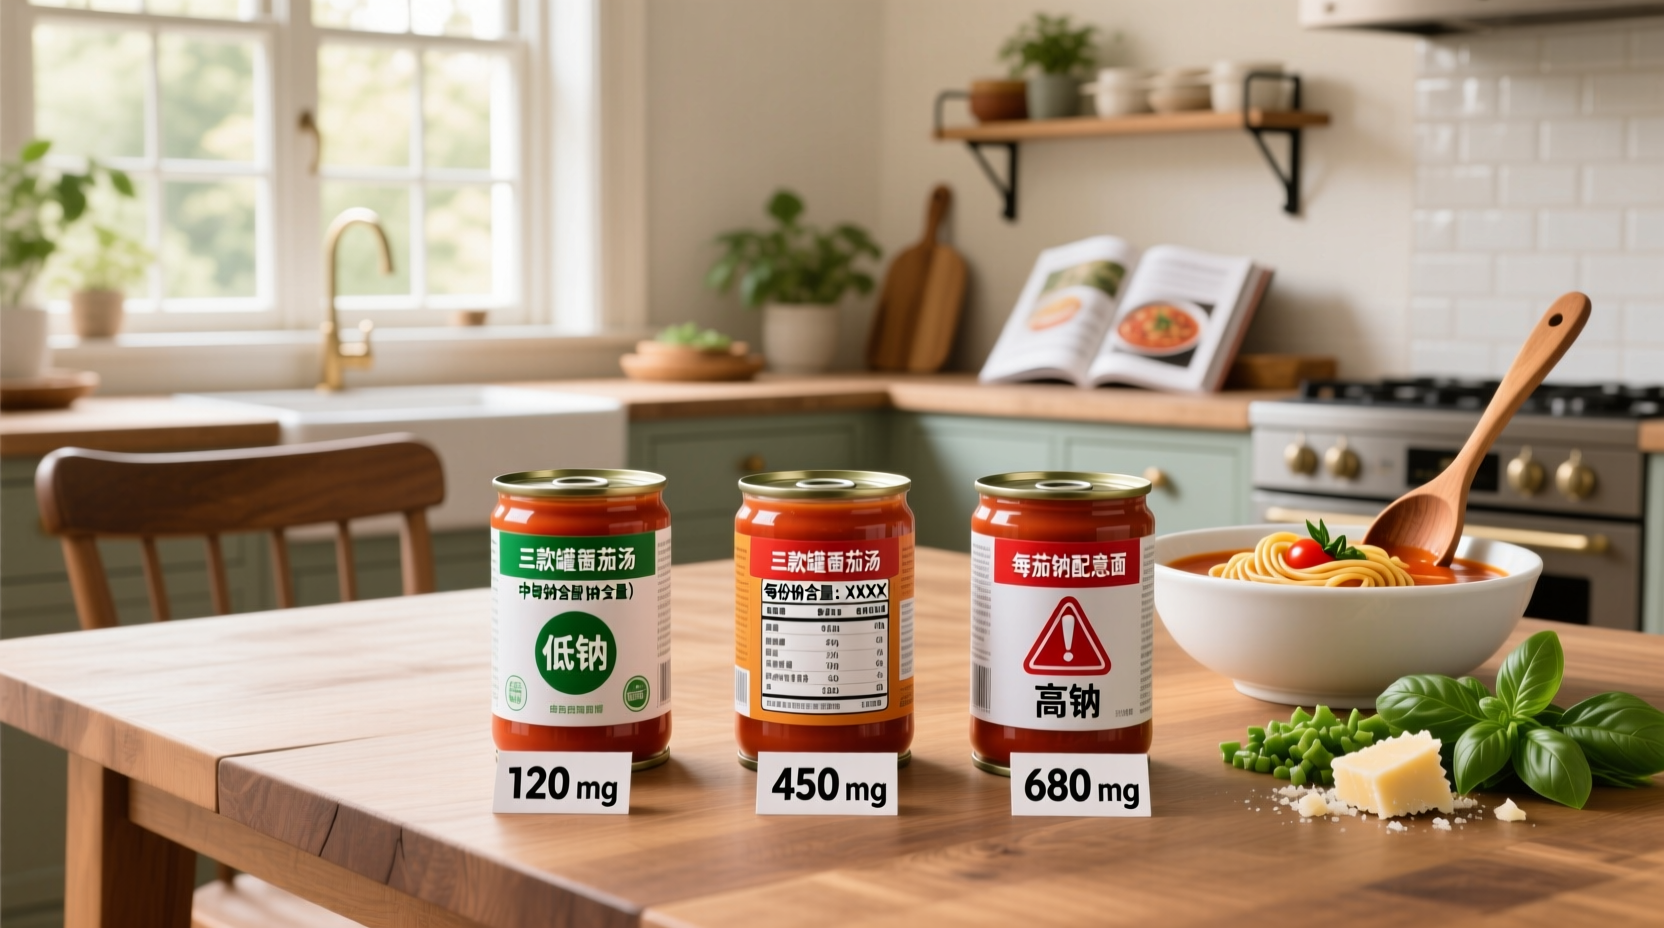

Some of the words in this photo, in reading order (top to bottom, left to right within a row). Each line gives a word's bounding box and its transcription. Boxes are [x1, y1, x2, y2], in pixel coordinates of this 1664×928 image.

[542, 634, 608, 671] 低钠
[1035, 683, 1101, 719] 高钠
[508, 765, 570, 800] 120
[576, 780, 618, 807] mg
[771, 767, 840, 801] 450
[845, 782, 887, 808] mg
[1024, 767, 1092, 802] 680
[1098, 783, 1140, 809] mg
